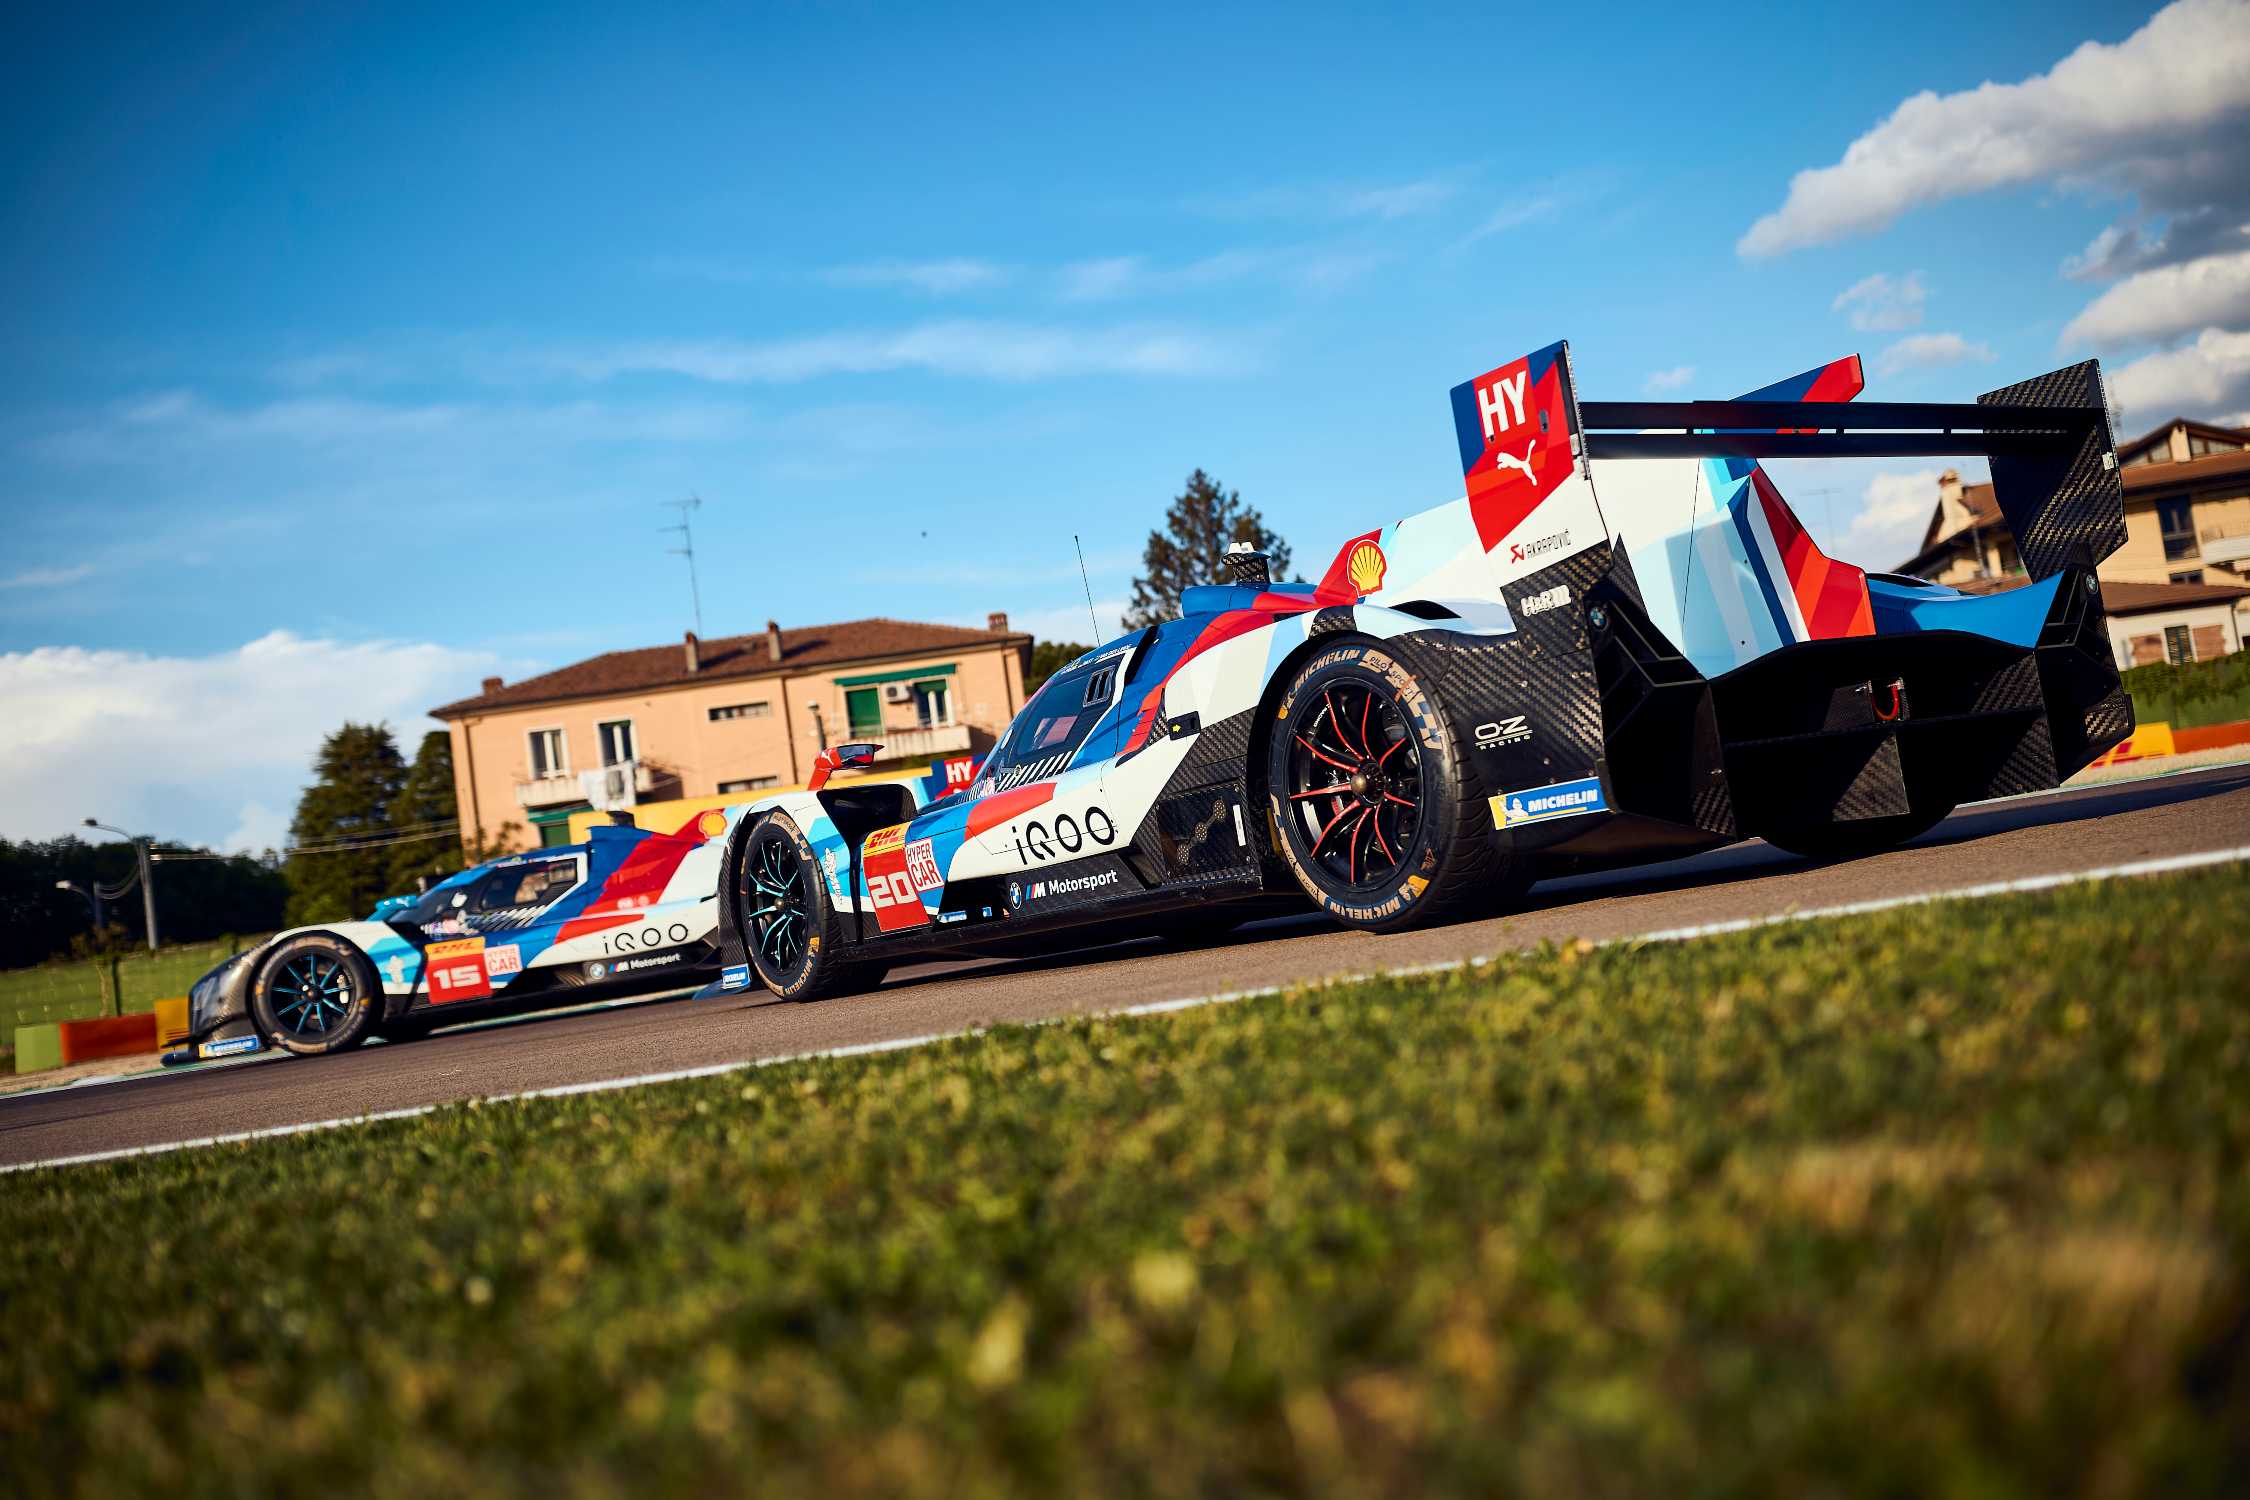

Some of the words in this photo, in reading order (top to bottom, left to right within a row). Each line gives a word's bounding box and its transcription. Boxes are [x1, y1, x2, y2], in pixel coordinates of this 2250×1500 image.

[1478, 370, 1527, 438] HY
[1295, 649, 1361, 689] MICHELIN
[1479, 734, 1531, 751] RACING
[946, 761, 974, 784] HY
[1528, 788, 1599, 813] MICHELIN
[869, 827, 901, 849] DHL
[906, 842, 933, 864] HYPER
[911, 859, 941, 888] CAR
[1048, 869, 1119, 896] Motorsport
[867, 870, 919, 909] 20
[1329, 895, 1401, 920] MICHELIN
[488, 957, 519, 973] CAR
[630, 952, 682, 970] Motorsport
[432, 964, 482, 990] 15
